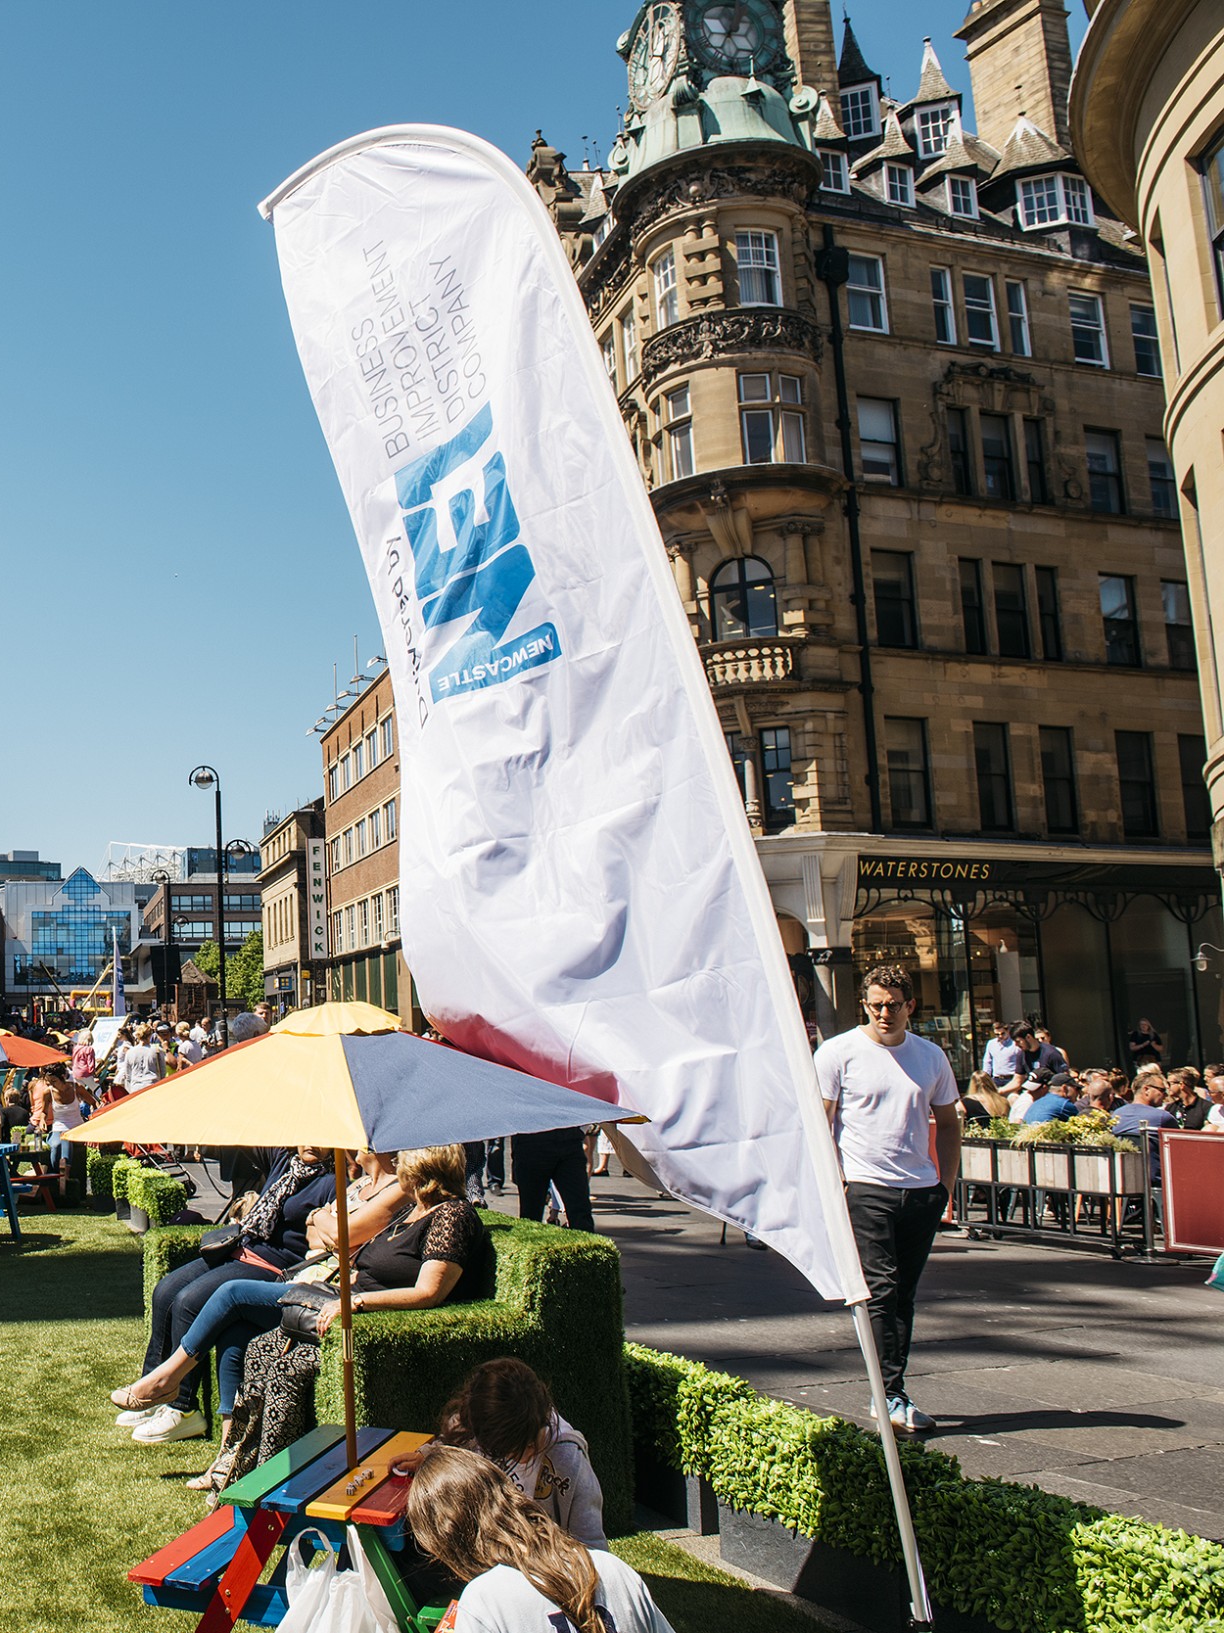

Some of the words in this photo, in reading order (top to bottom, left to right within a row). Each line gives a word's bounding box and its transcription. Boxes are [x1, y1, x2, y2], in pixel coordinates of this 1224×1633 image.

[363, 240, 438, 442] IMPROVEMENT
[408, 293, 467, 424] DISTRICT
[429, 255, 486, 399] COMPANY
[352, 317, 410, 459] BUSINESS
[385, 536, 402, 574] by
[437, 634, 555, 691] NEWCASTLE
[312, 846, 324, 952] FENWICK
[859, 860, 991, 880] WATERSTONES
[541, 1464, 571, 1497] Rock
